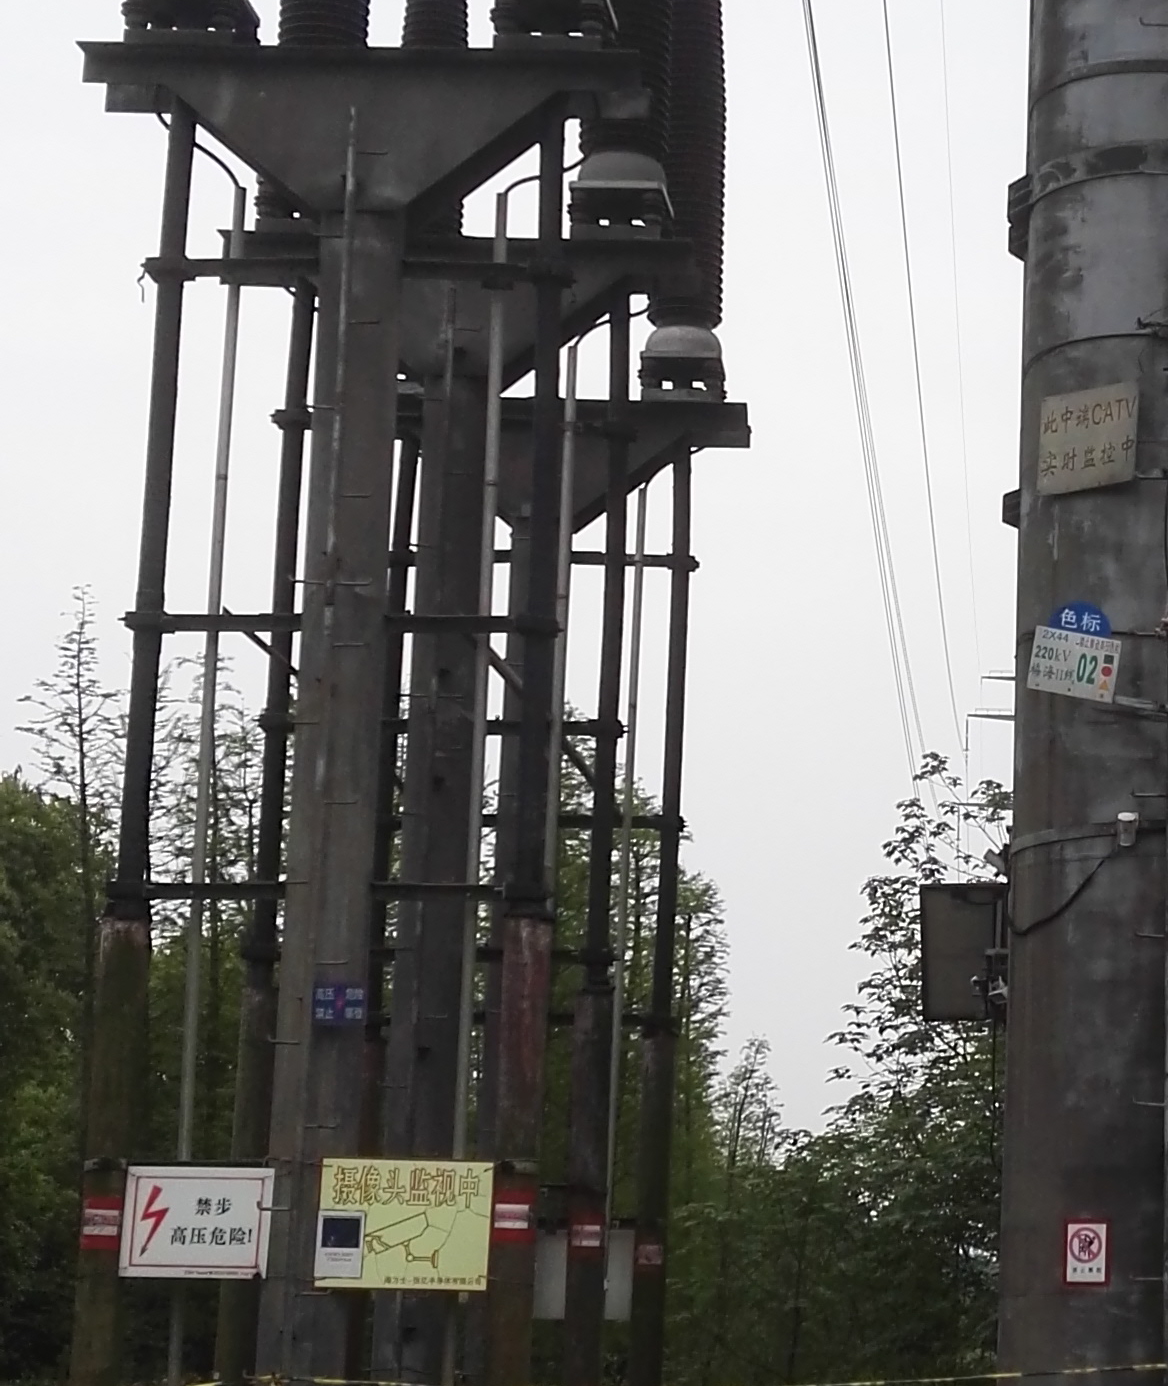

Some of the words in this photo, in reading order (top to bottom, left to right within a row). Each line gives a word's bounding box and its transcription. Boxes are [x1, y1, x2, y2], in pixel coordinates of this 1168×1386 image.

[1041, 435, 1135, 477] 实时监控中
[1061, 609, 1101, 632] 色标
[1035, 645, 1071, 662] 220kV
[1077, 653, 1098, 685] 02
[332, 1165, 480, 1209] 摄像头监视中
[195, 1197, 232, 1216] 禁步
[170, 1226, 252, 1246] 高压危险!
